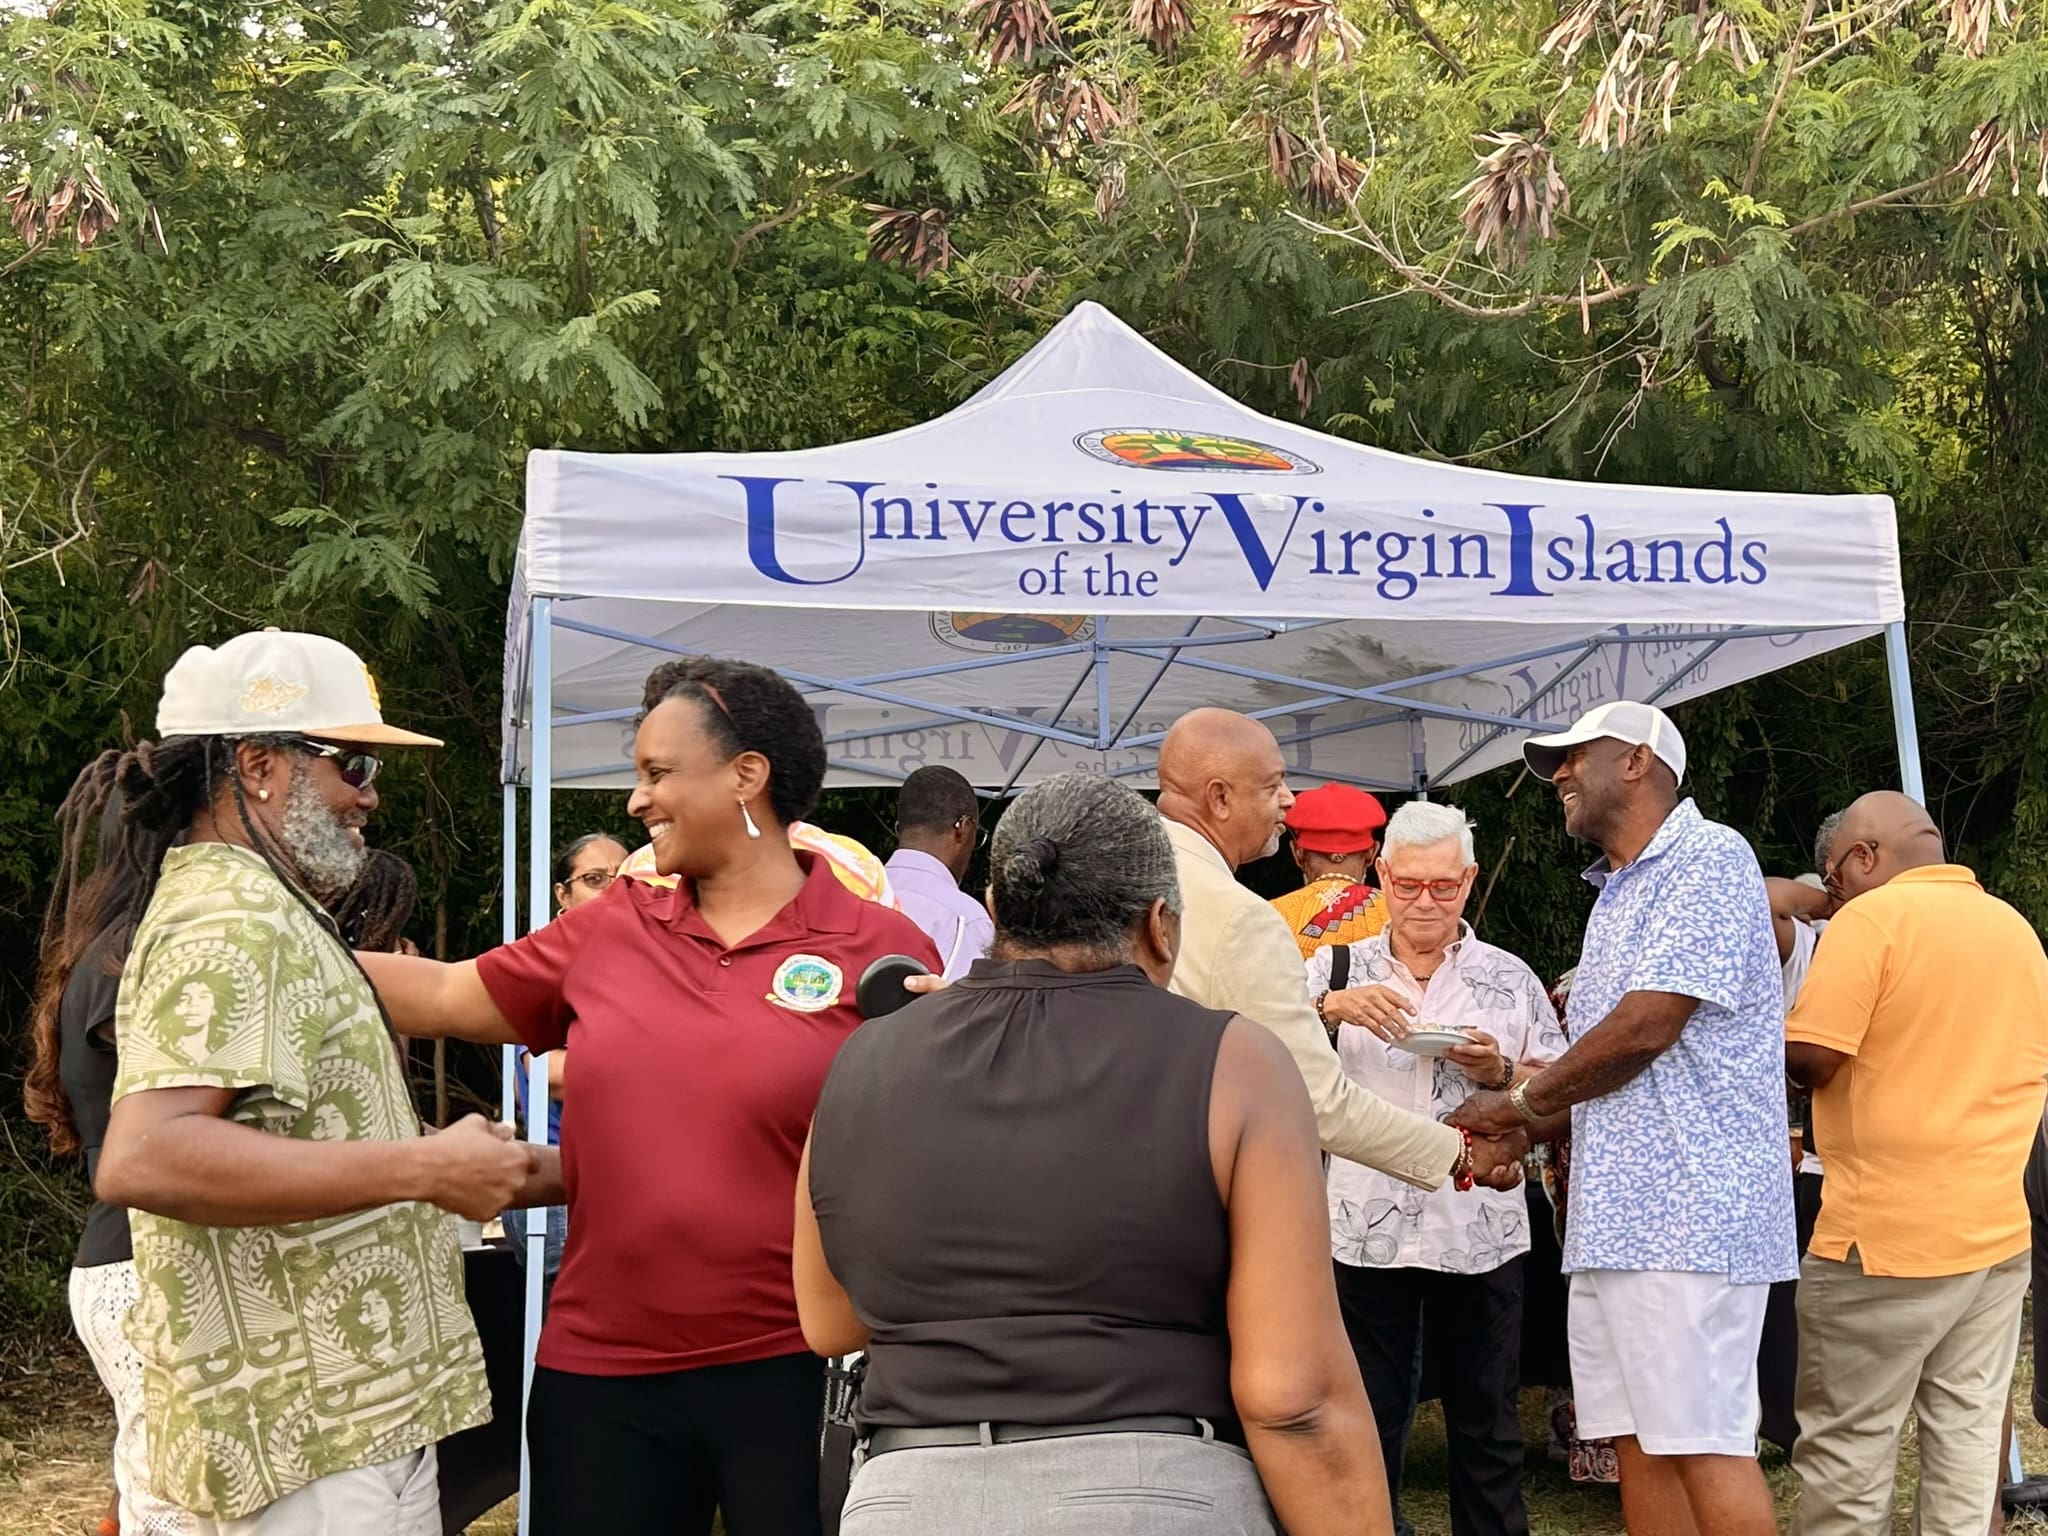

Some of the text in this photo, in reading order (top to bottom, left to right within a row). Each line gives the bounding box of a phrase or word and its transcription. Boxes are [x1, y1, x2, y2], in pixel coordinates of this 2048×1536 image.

[717, 474, 1769, 601] University Virgin Islands
[1018, 551, 1159, 598] of the
